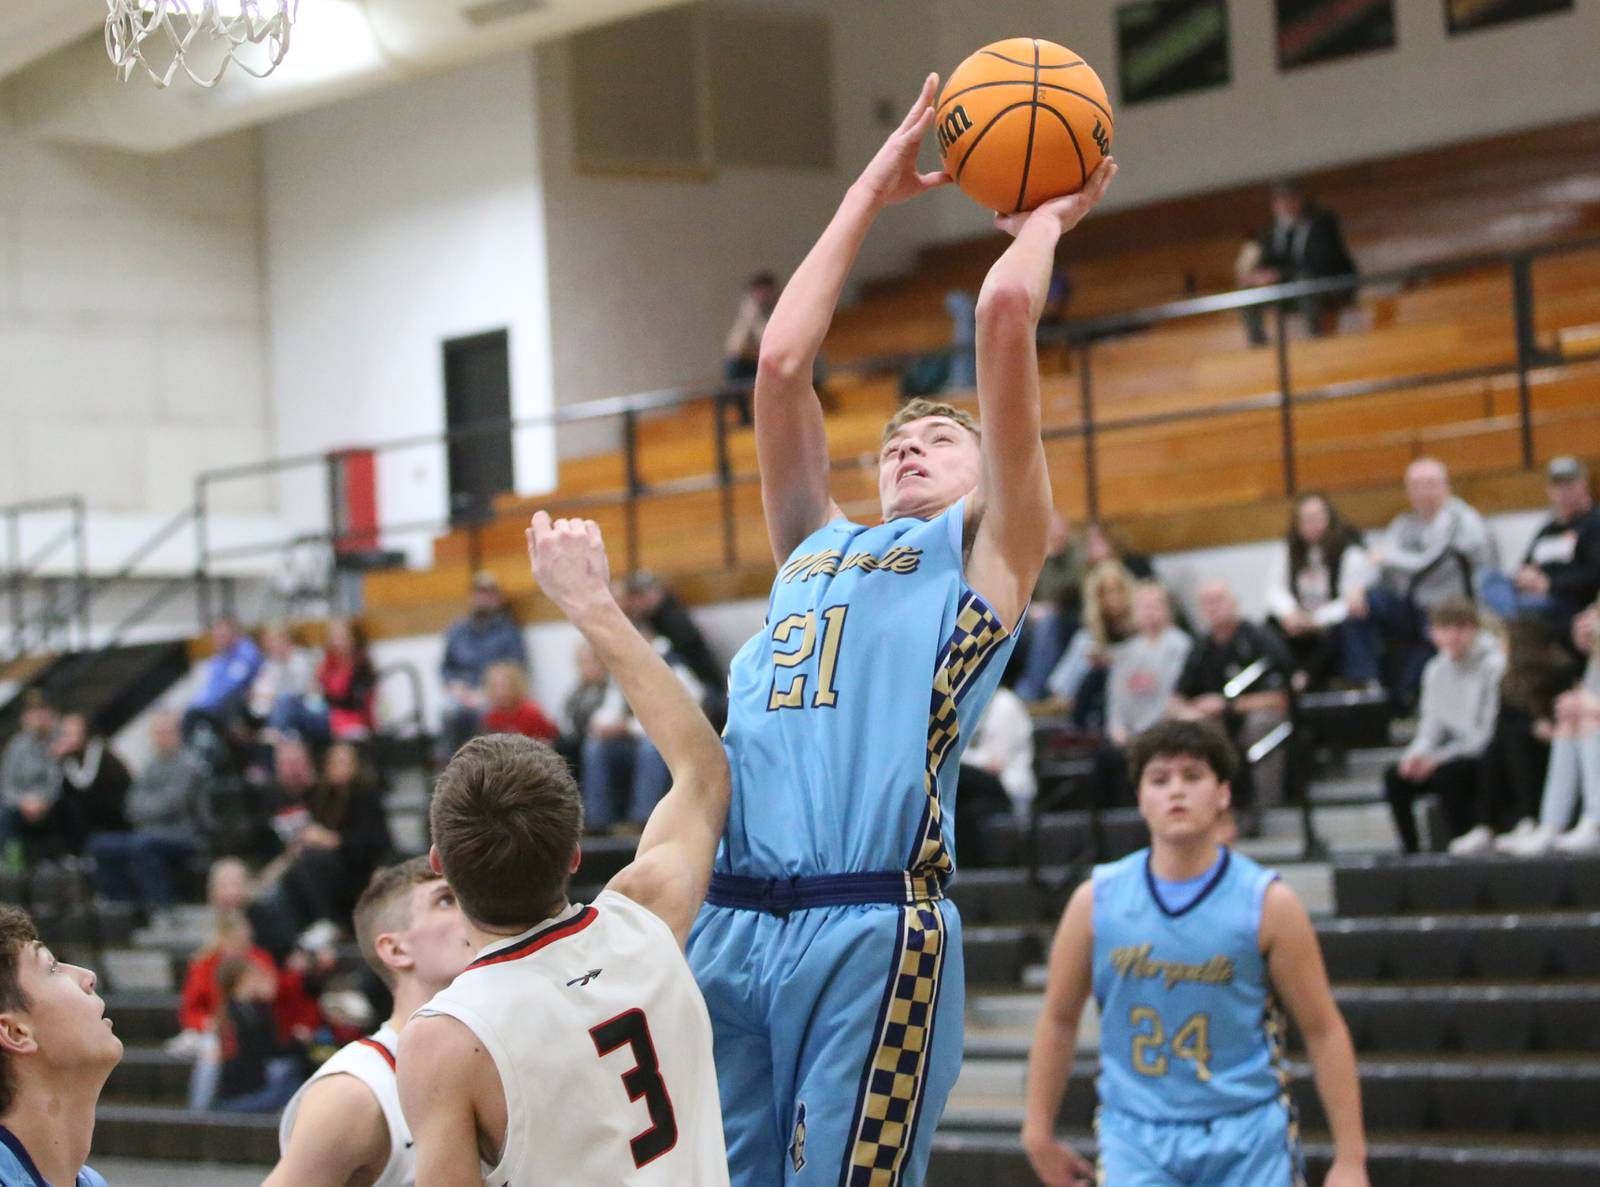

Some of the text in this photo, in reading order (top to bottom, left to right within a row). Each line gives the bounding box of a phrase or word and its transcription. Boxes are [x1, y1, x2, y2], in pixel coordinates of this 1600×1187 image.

[766, 603, 849, 712] 21
[588, 1007, 678, 1169] 3
[1129, 1004, 1212, 1082] 24
